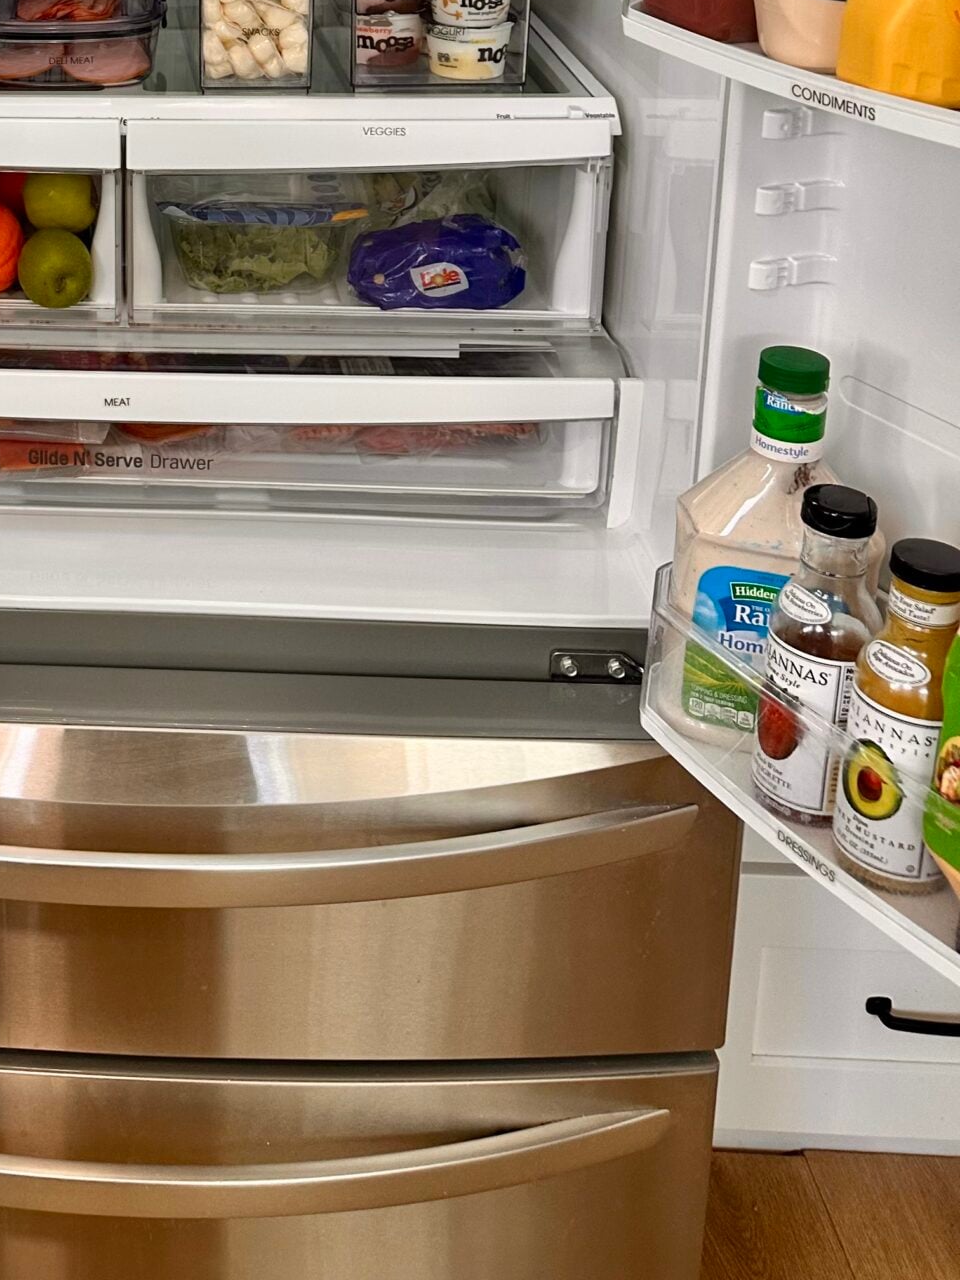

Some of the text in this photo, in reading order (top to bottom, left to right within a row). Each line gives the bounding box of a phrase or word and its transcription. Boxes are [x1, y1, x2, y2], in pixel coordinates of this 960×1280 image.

[242, 28, 280, 36] SNACKS
[48, 56, 94, 65] DELI MEAT
[791, 84, 876, 121] CONDIMENTS
[363, 126, 406, 137] VEGGIES
[420, 267, 461, 288] Dole
[104, 398, 131, 407] MEAT
[756, 435, 809, 458] Homestyle
[28, 449, 214, 470] Glide N' Serve Drawer
[779, 672, 801, 690] Style
[855, 824, 916, 852] MUSTARD
[777, 830, 836, 882] DRESSINGS
